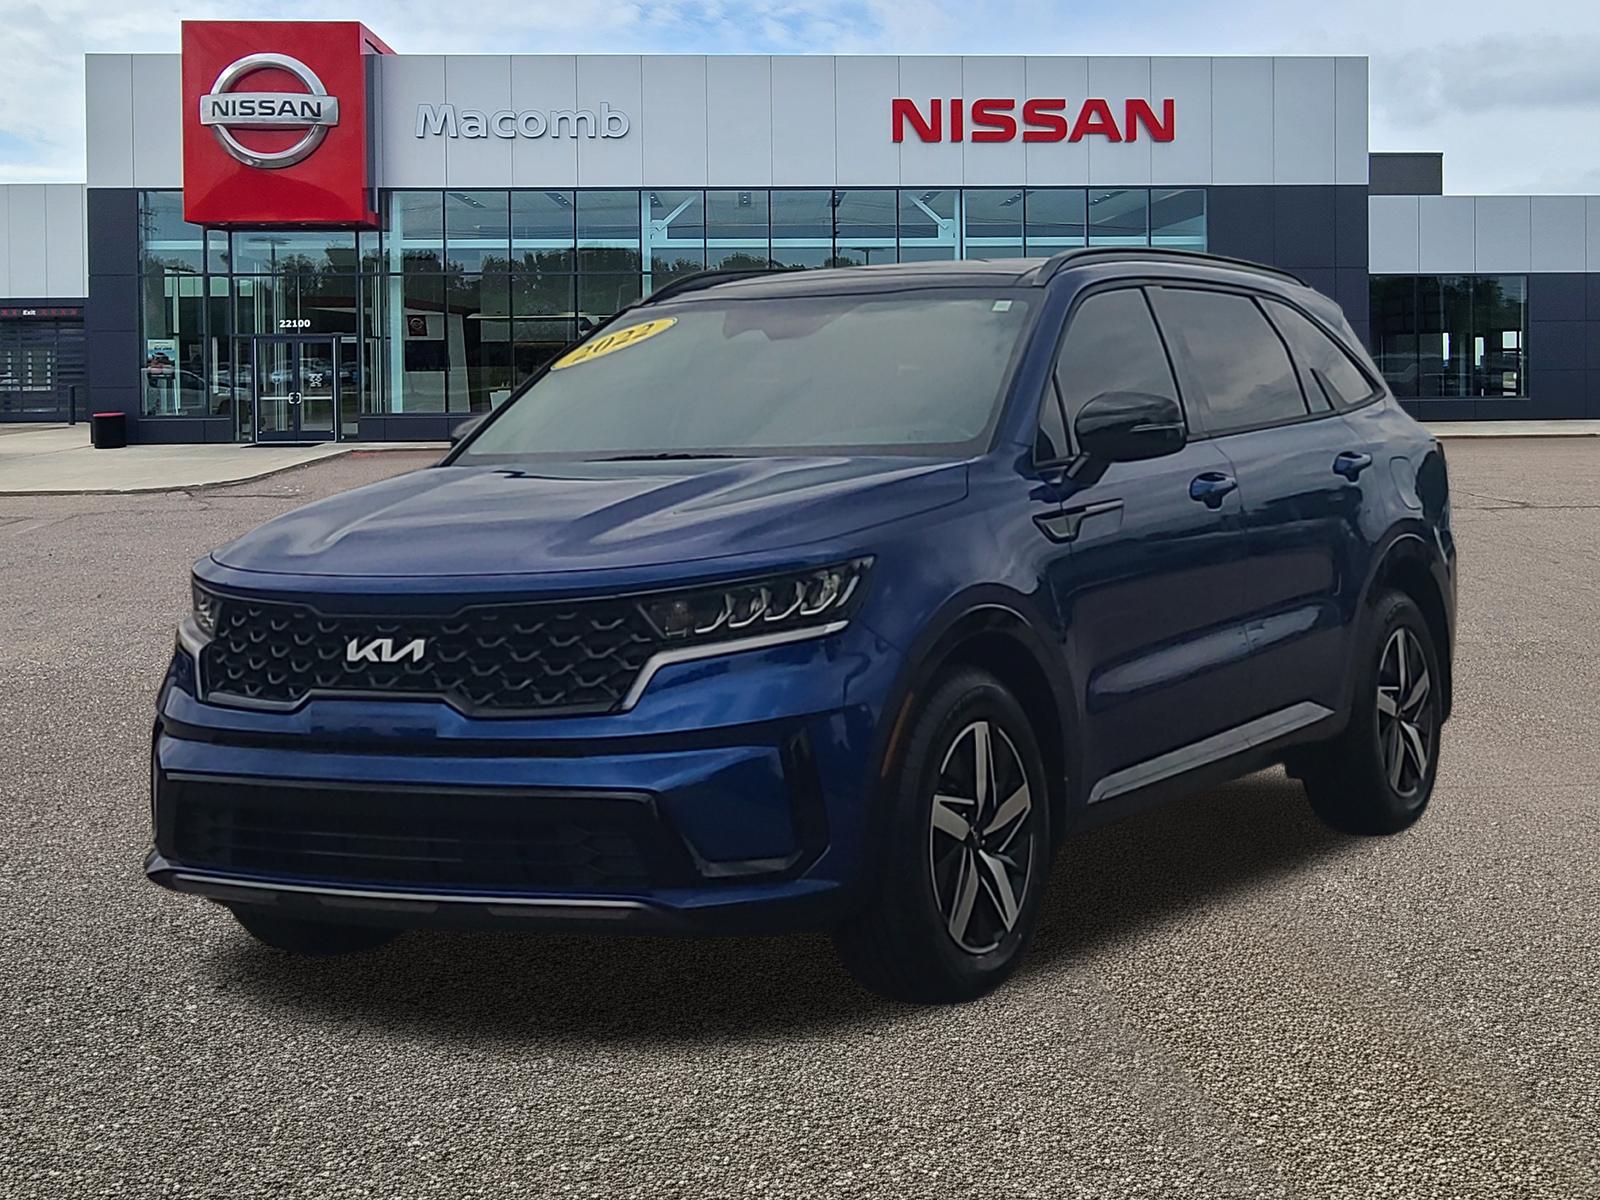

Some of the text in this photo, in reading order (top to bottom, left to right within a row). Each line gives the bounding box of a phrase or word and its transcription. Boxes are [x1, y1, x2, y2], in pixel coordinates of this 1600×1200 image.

[212, 100, 322, 118] NISSAN
[415, 101, 630, 139] Macomb
[892, 98, 1175, 143] NISSAN
[279, 319, 311, 328] 22100
[571, 323, 656, 363] 2022
[347, 637, 425, 662] KIA
